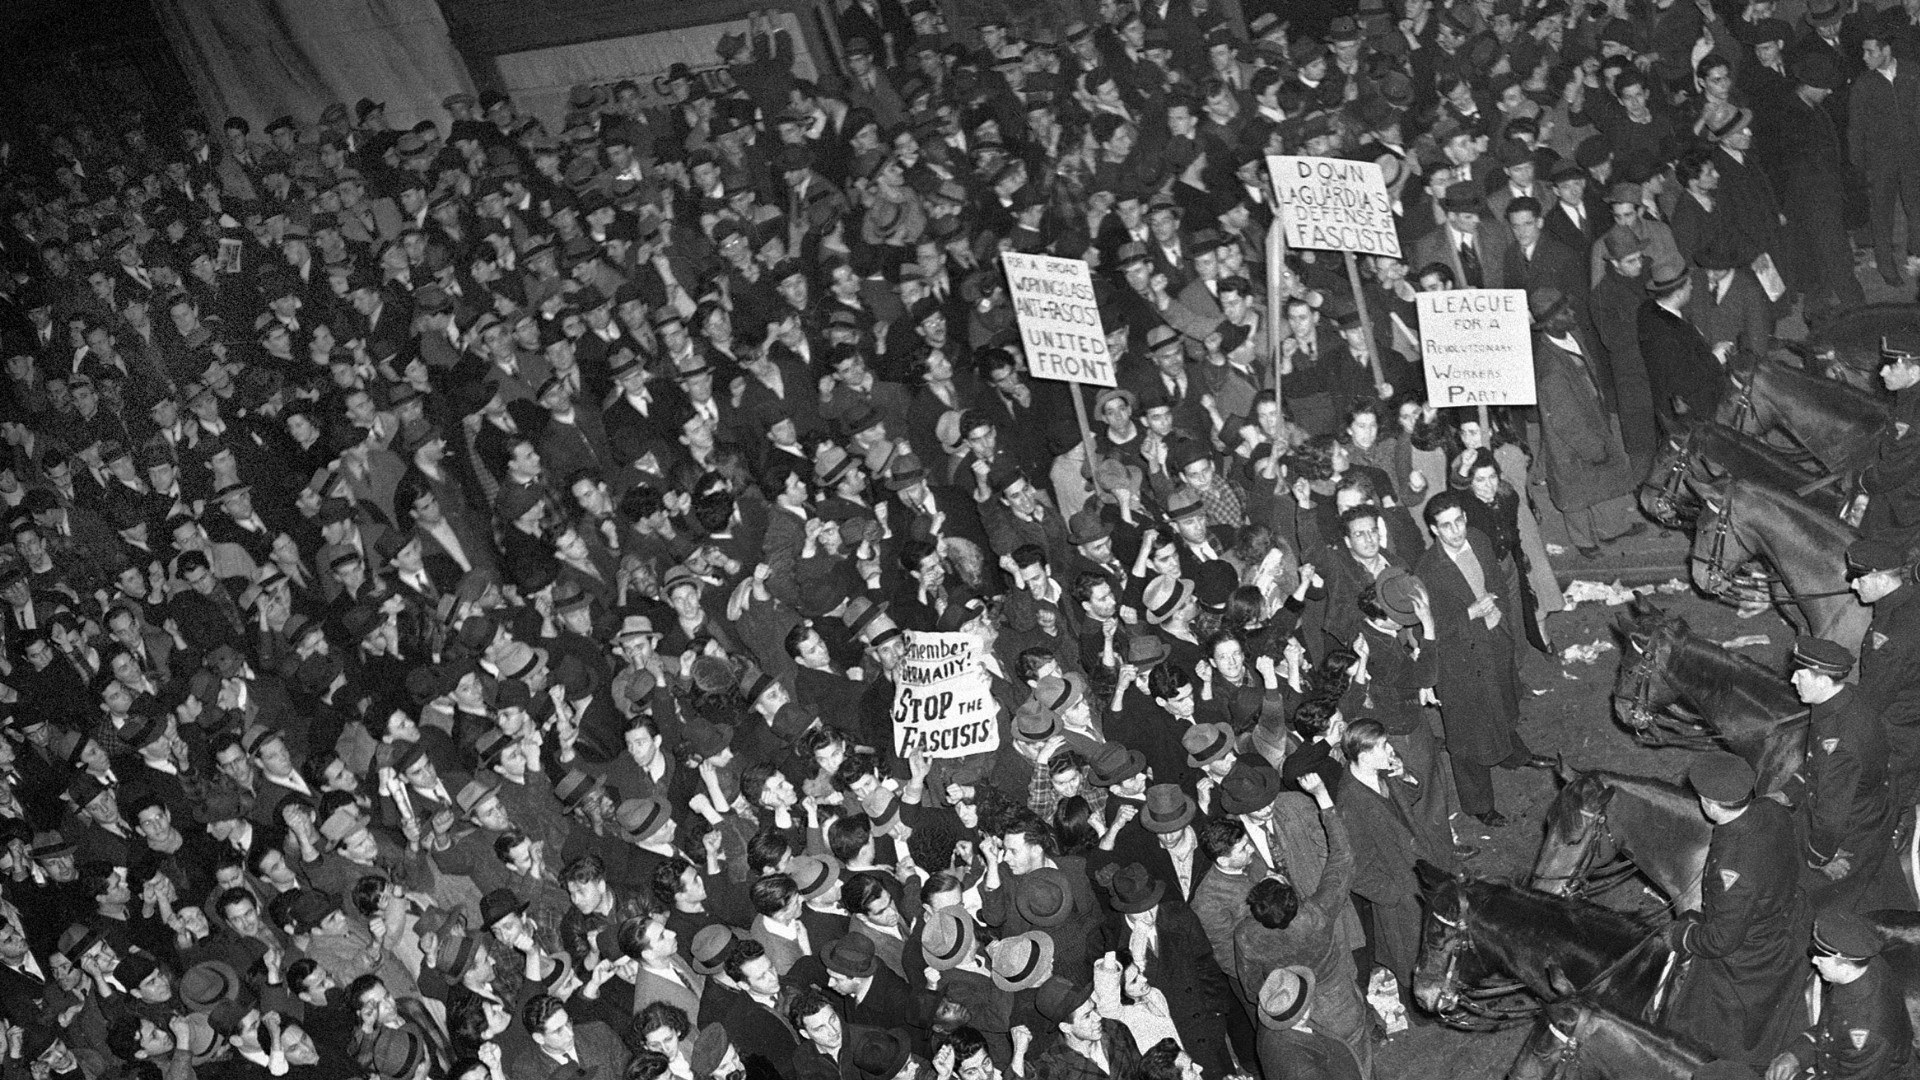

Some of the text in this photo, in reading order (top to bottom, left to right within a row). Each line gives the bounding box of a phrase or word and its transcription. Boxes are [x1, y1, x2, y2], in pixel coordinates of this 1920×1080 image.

[1297, 161, 1364, 183] DOWN
[1296, 205, 1374, 226] DEFENSE
[1297, 224, 1398, 254] FASCISTS
[1031, 260, 1038, 270] A
[1046, 261, 1078, 275] BROAD
[1432, 295, 1515, 313] LEAGUE
[1455, 319, 1500, 330] FOR A
[1028, 328, 1105, 355] UNITED
[1038, 352, 1107, 380] FRONT
[1448, 386, 1507, 403] PARTY
[894, 688, 982, 723] STOP THE
[900, 718, 990, 758] FASCISTS
